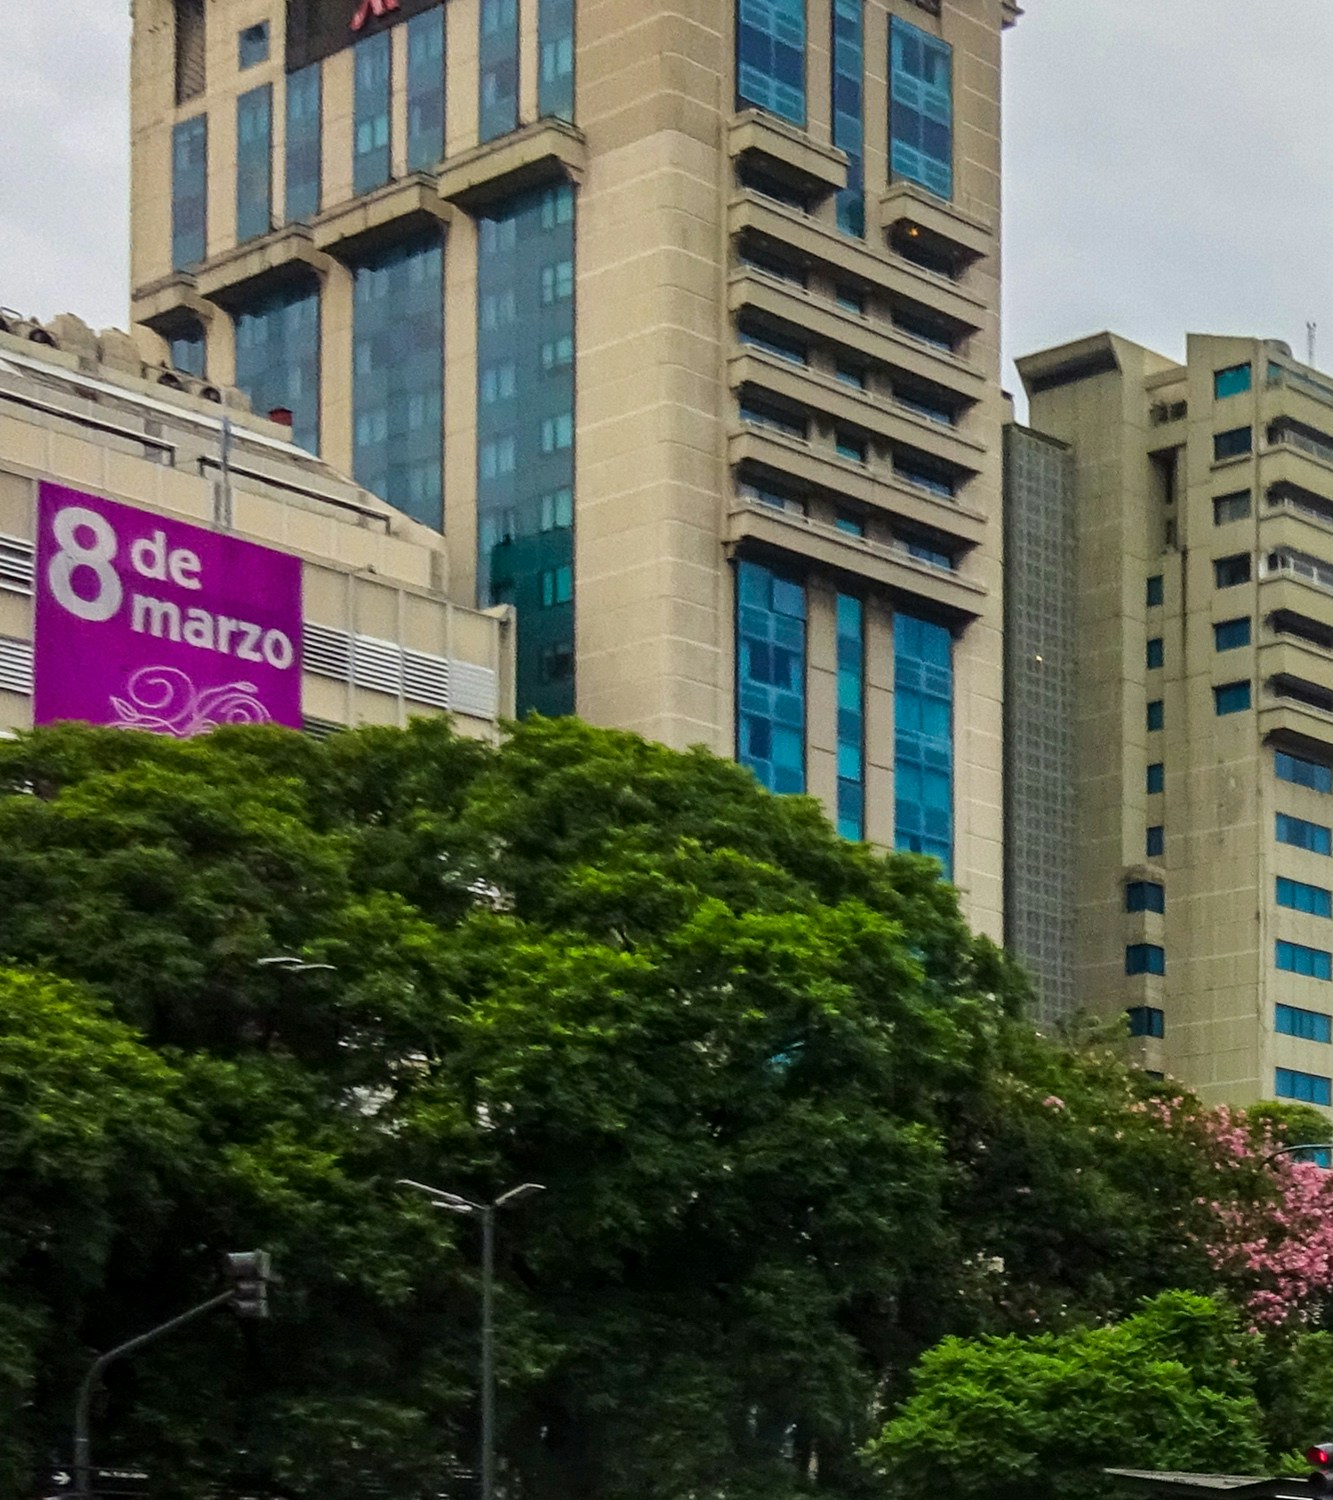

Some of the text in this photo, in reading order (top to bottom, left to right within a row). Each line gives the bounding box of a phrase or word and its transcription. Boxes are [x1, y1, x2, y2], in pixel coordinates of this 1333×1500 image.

[48, 507, 202, 622] 8 de
[131, 594, 294, 671] marzo
